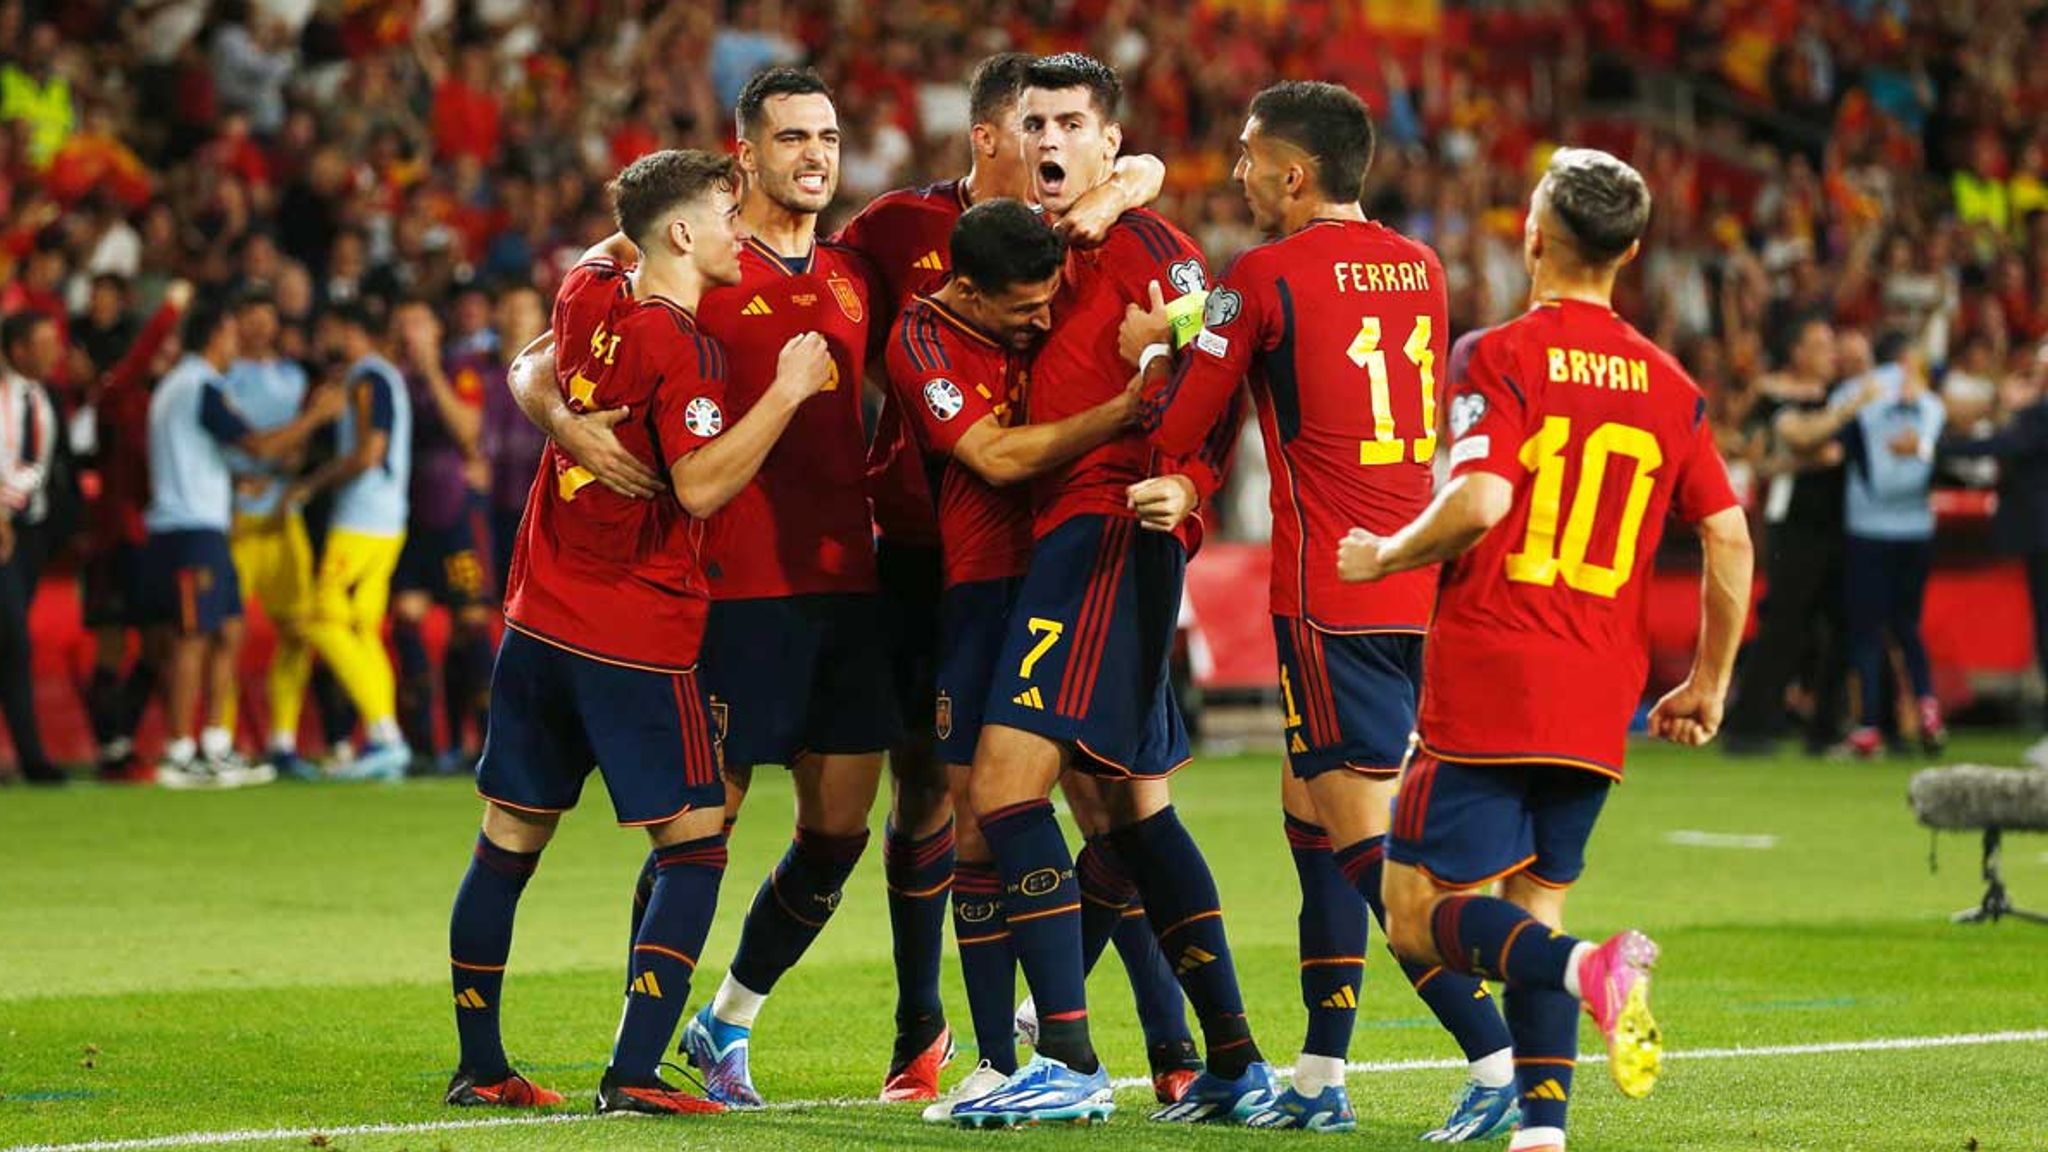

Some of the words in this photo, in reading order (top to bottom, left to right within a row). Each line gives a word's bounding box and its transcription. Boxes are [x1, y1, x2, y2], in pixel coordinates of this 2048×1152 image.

[1333, 260, 1430, 292] FERRAN
[1346, 315, 1437, 465] 11
[1547, 346, 1649, 394] BRYAN
[1505, 415, 1663, 599] 10
[1019, 616, 1064, 679] 7
